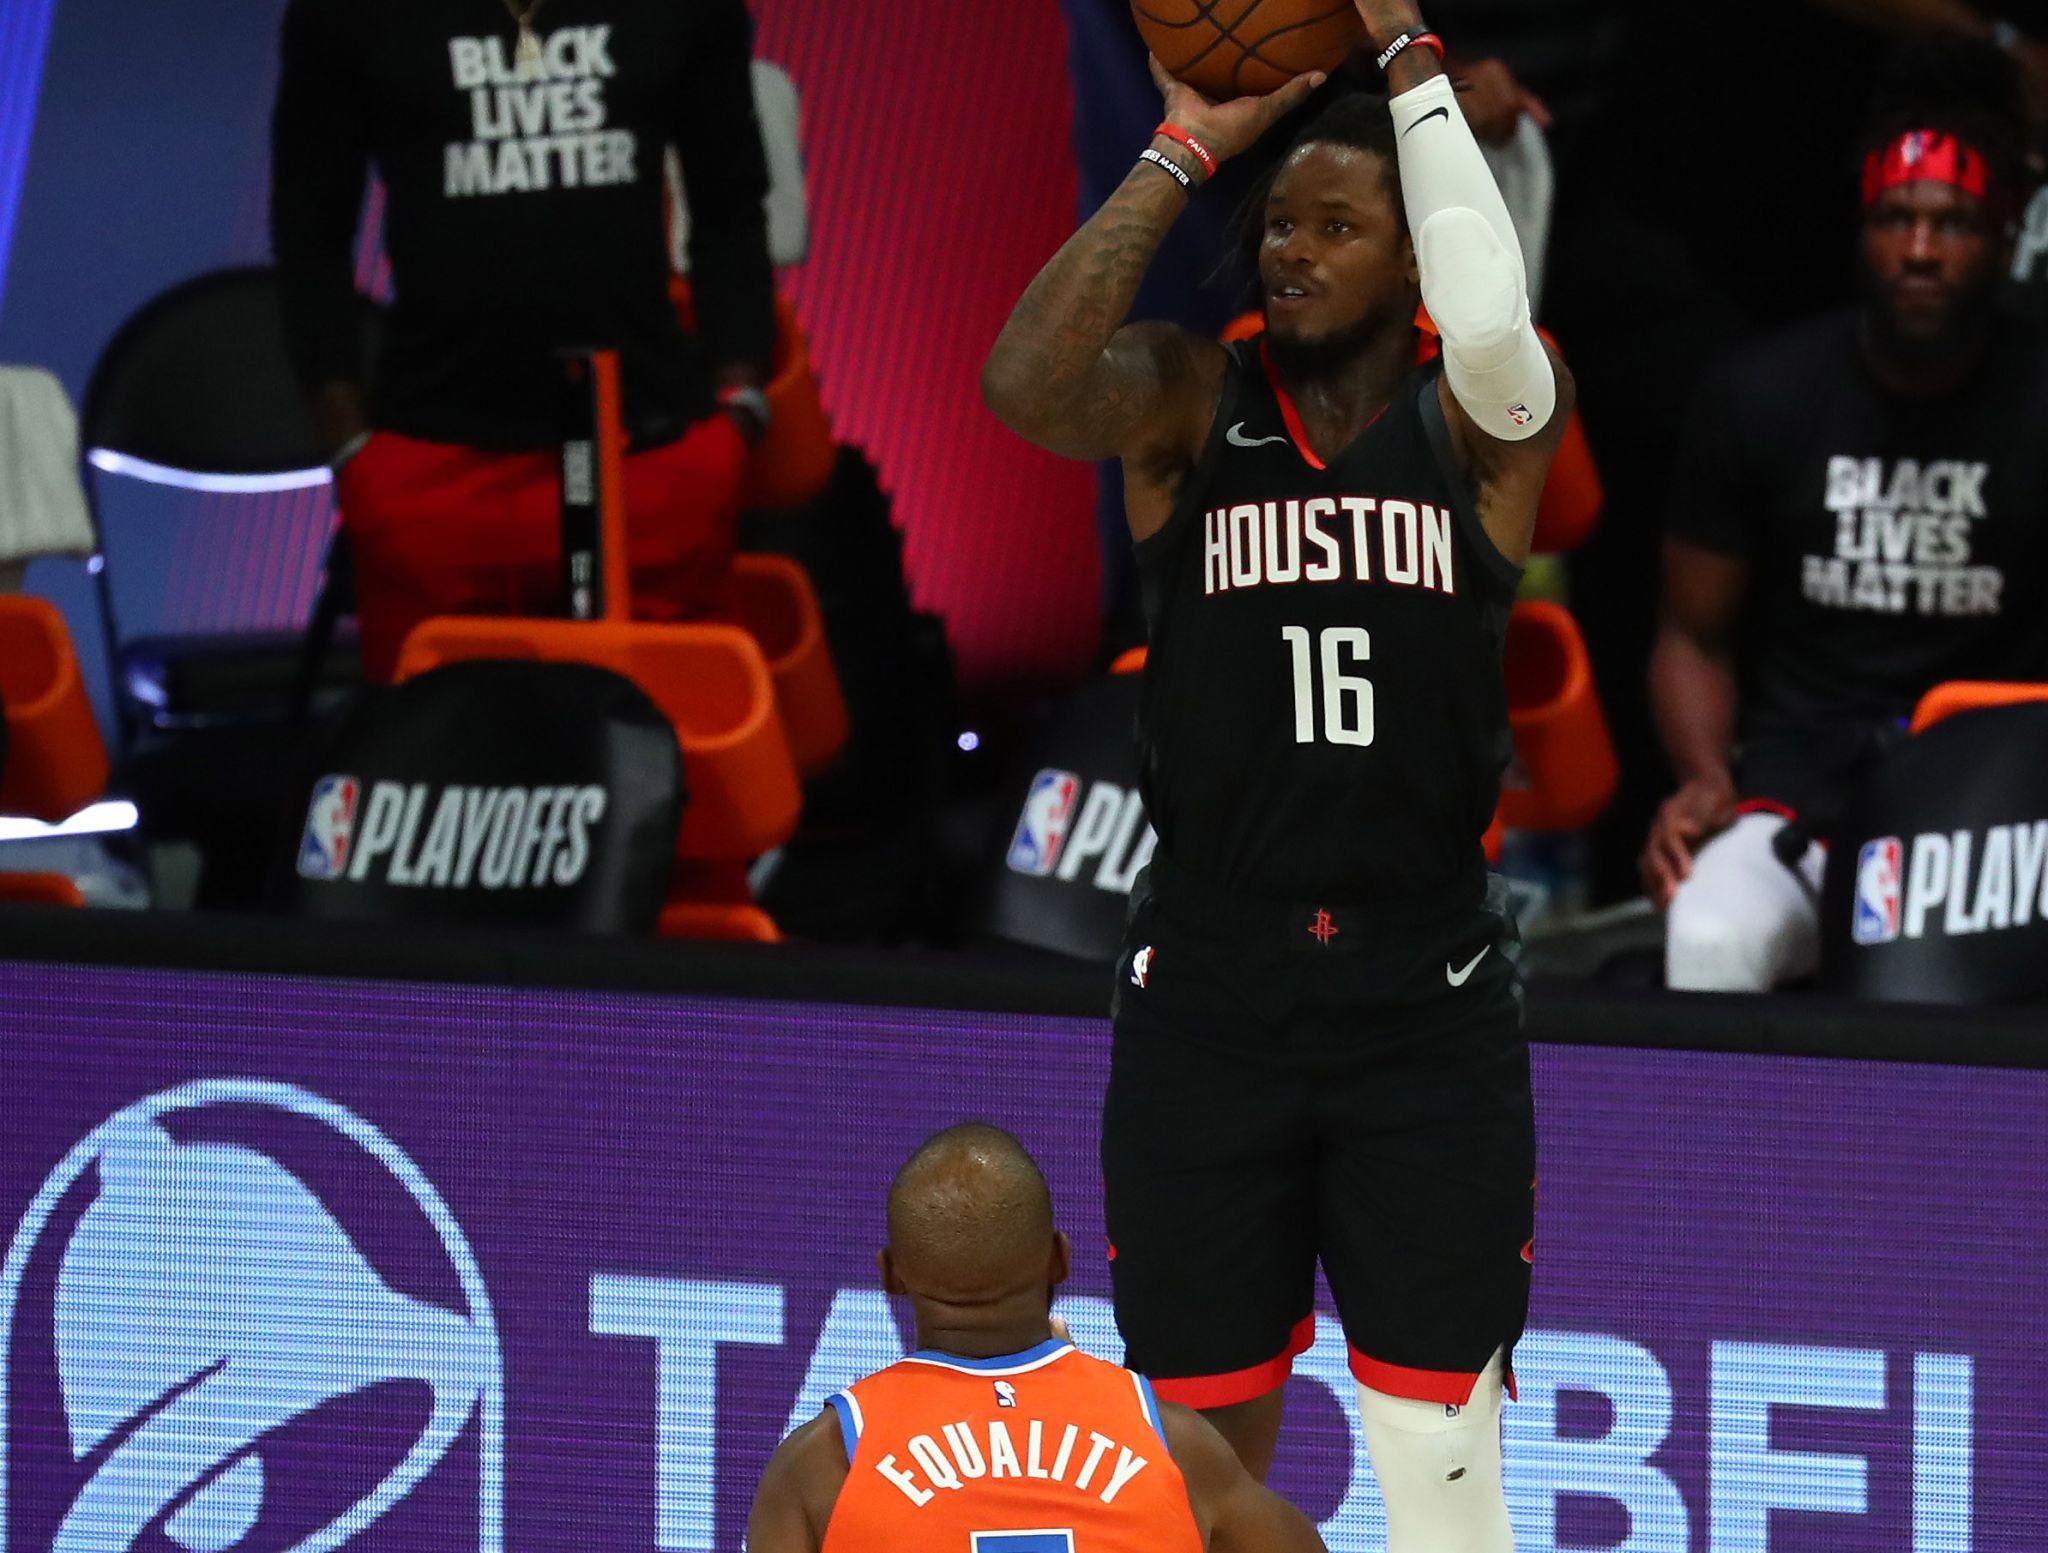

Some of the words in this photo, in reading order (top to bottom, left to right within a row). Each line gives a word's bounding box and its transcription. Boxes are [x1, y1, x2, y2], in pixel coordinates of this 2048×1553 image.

[449, 24, 617, 89] BLACK
[470, 79, 607, 140] LIVES
[443, 129, 639, 197] MATTER
[1158, 156, 1190, 186] MATTER
[1186, 137, 1210, 162] FAITH
[1825, 455, 1989, 518] BLACK
[1203, 496, 1456, 596] HOUSTON
[1836, 509, 1972, 564] LIVES
[1802, 554, 2004, 616] MATTER
[1281, 625, 1375, 748] 16
[347, 778, 607, 889] PLAYOFFS
[1903, 818, 2048, 939] PLAY
[874, 1419, 1149, 1508] EQUALITY
